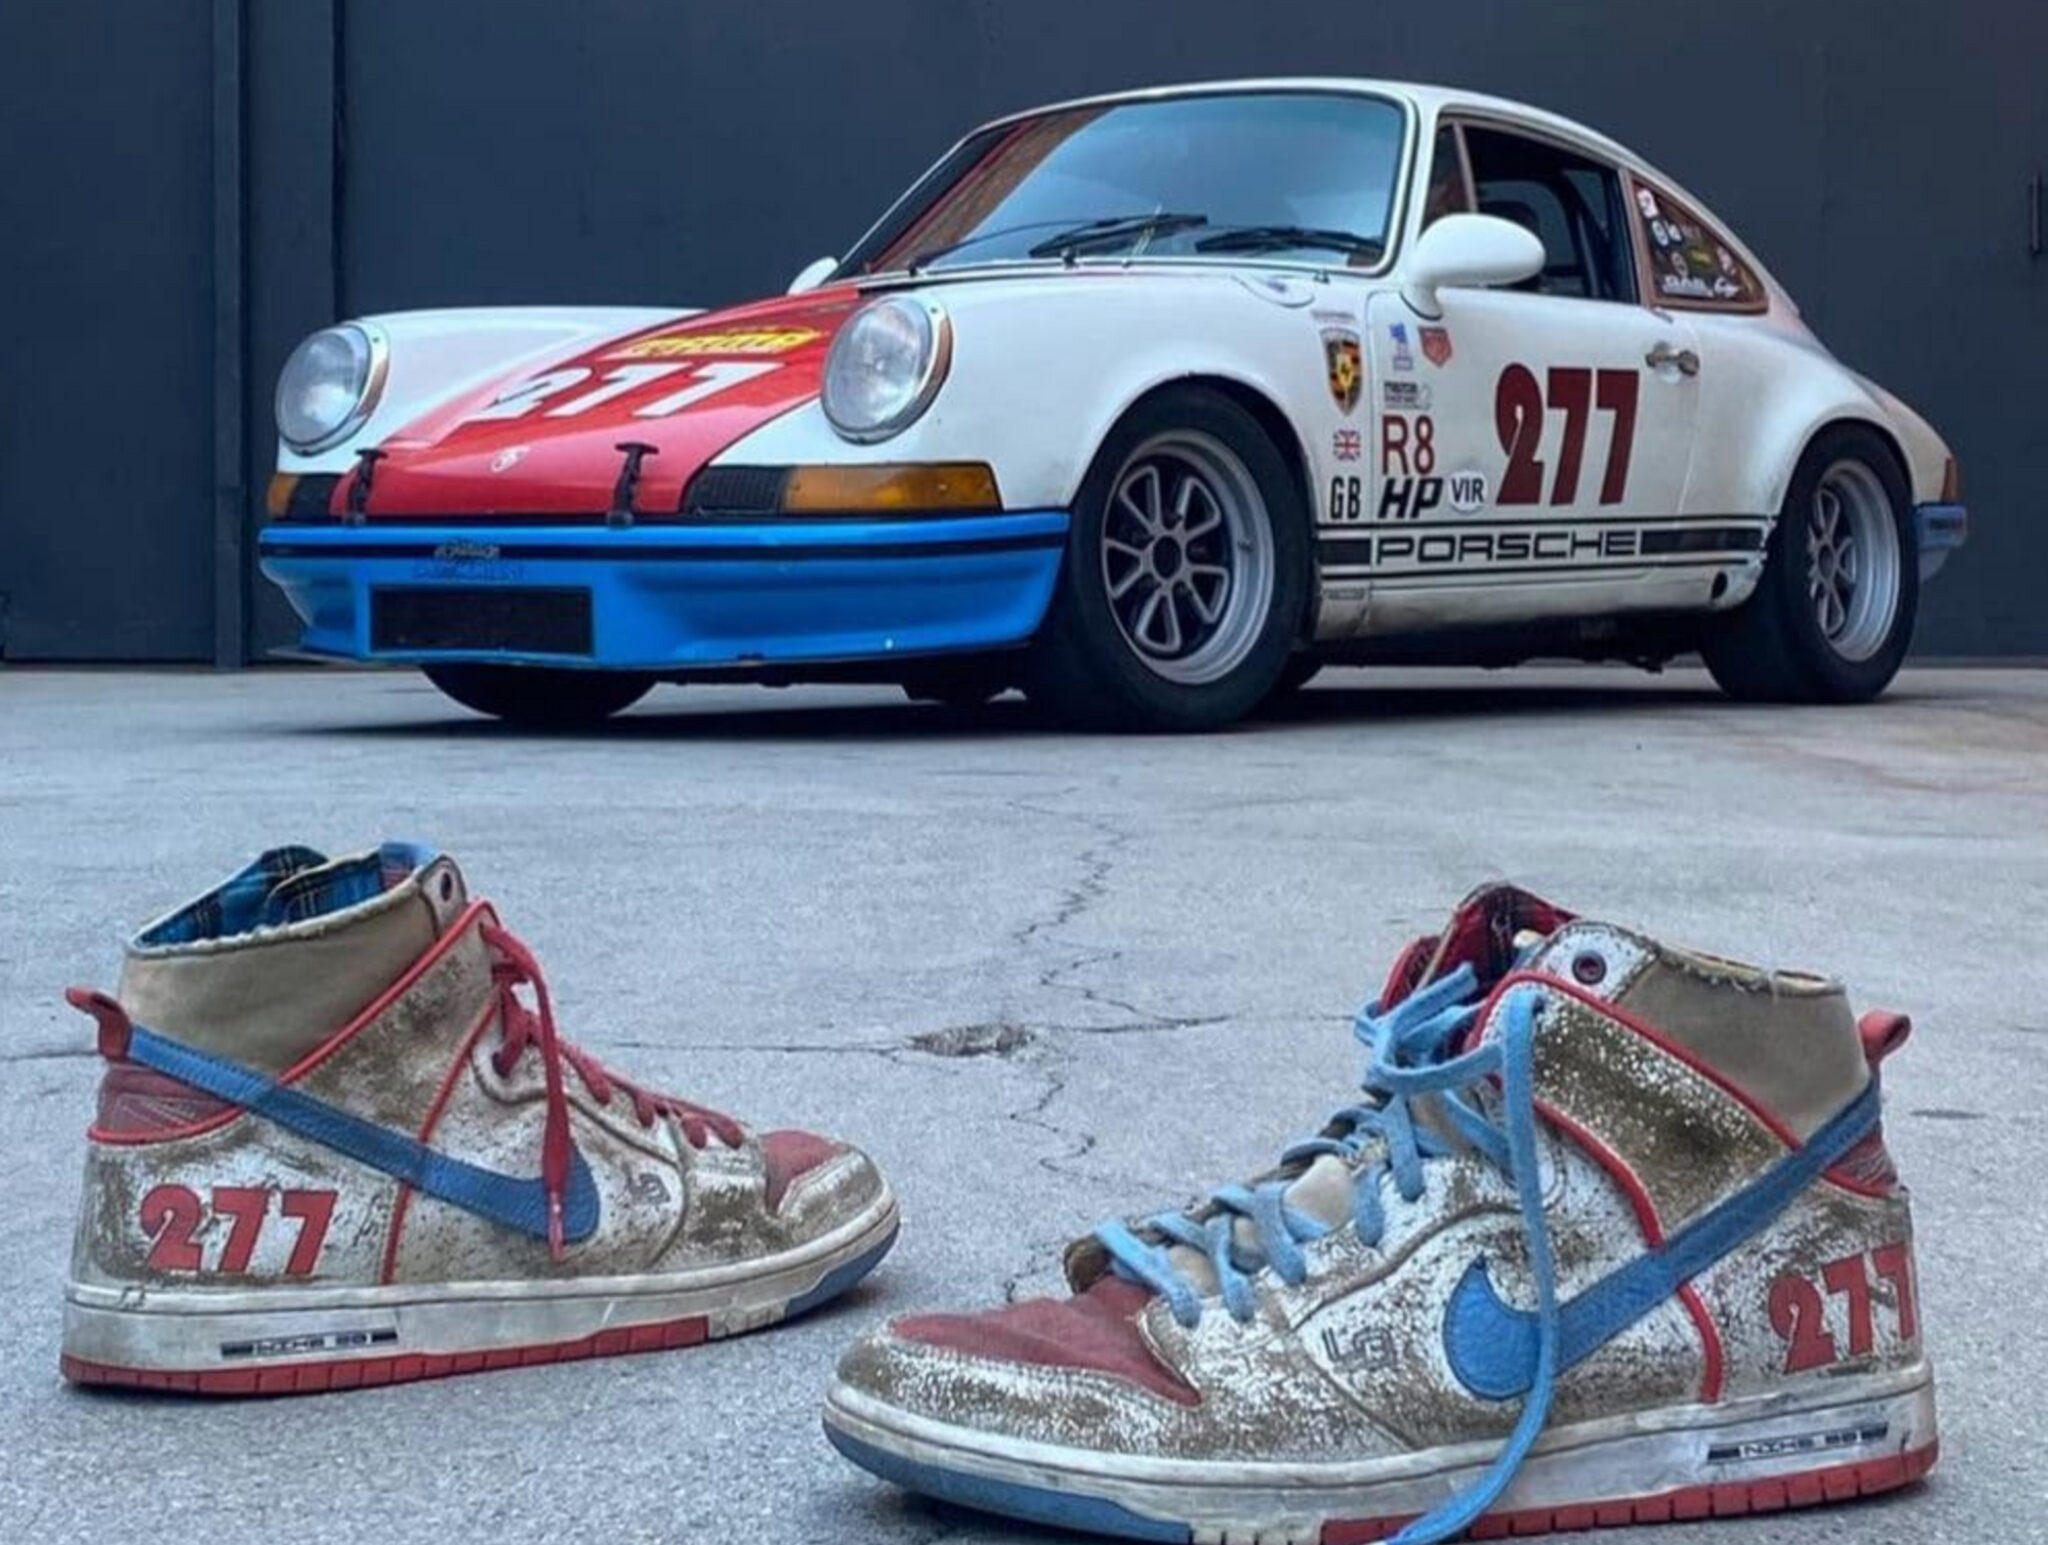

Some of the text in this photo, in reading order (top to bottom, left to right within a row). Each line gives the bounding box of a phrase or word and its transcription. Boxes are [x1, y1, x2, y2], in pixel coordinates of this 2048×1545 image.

[466, 362, 787, 420] 277
[1381, 414, 1435, 477] R8
[1494, 362, 1640, 507] 277
[1329, 476, 1362, 520] GB
[1377, 477, 1444, 519] HP
[1450, 476, 1485, 504] VIR
[1375, 529, 1639, 565] PORSCHE
[139, 1183, 338, 1276] 277
[1767, 1242, 1916, 1377] 277
